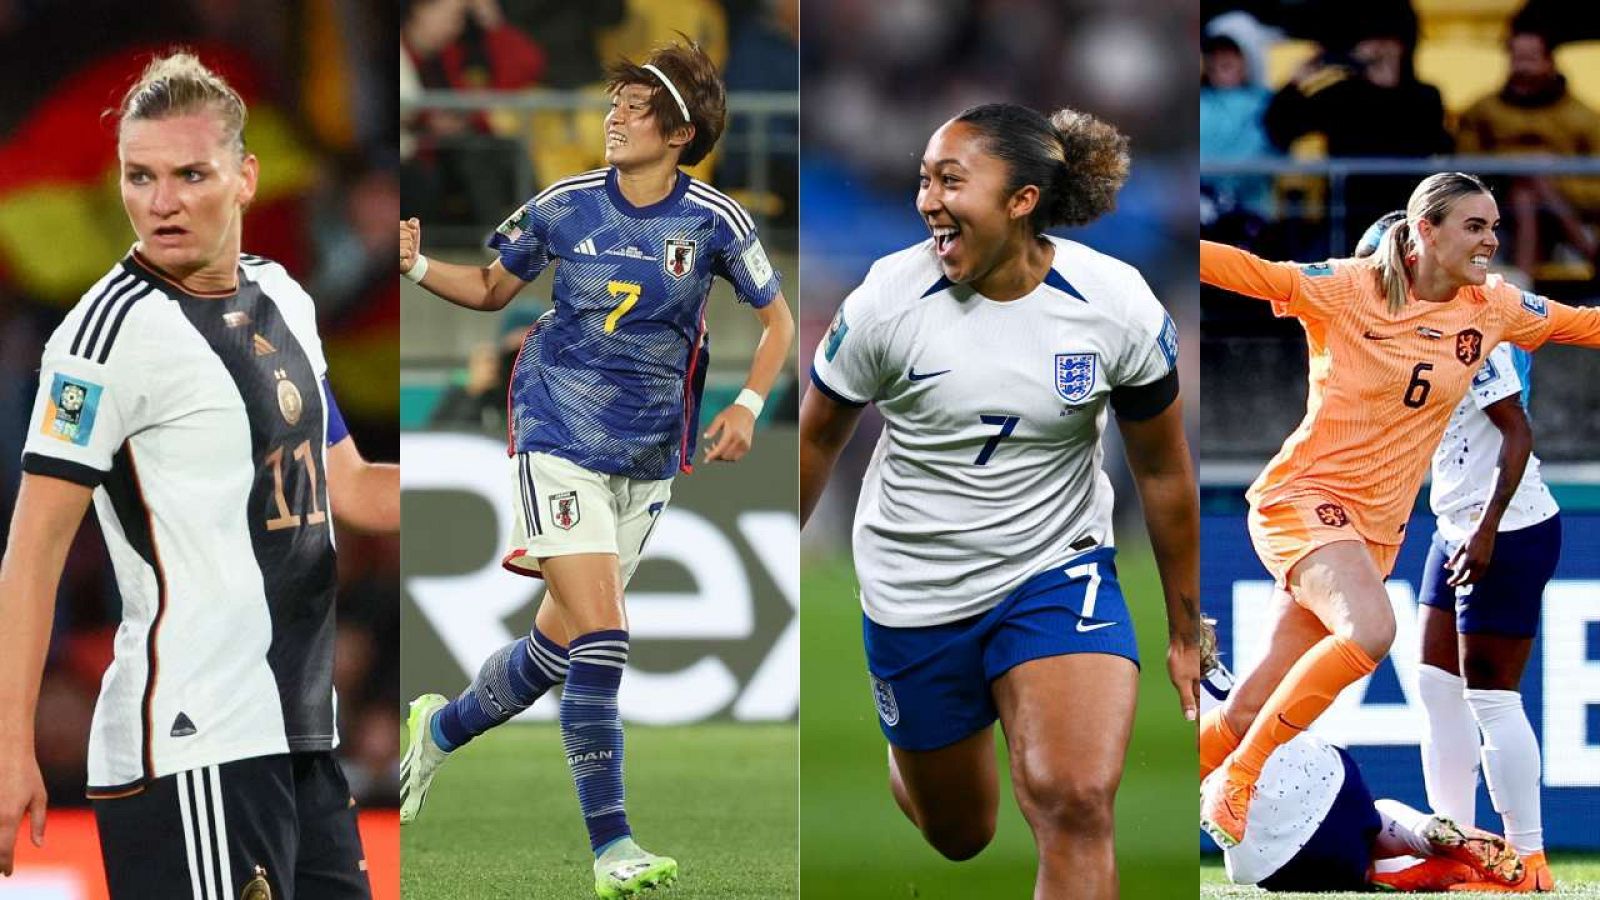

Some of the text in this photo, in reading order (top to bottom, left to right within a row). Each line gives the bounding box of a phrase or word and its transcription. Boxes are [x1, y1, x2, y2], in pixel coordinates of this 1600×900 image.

[604, 280, 641, 336] 7
[1403, 362, 1433, 409] 6
[974, 414, 1020, 466] 7
[265, 440, 326, 531] 11
[638, 501, 665, 555] 7
[1064, 562, 1101, 619] 7
